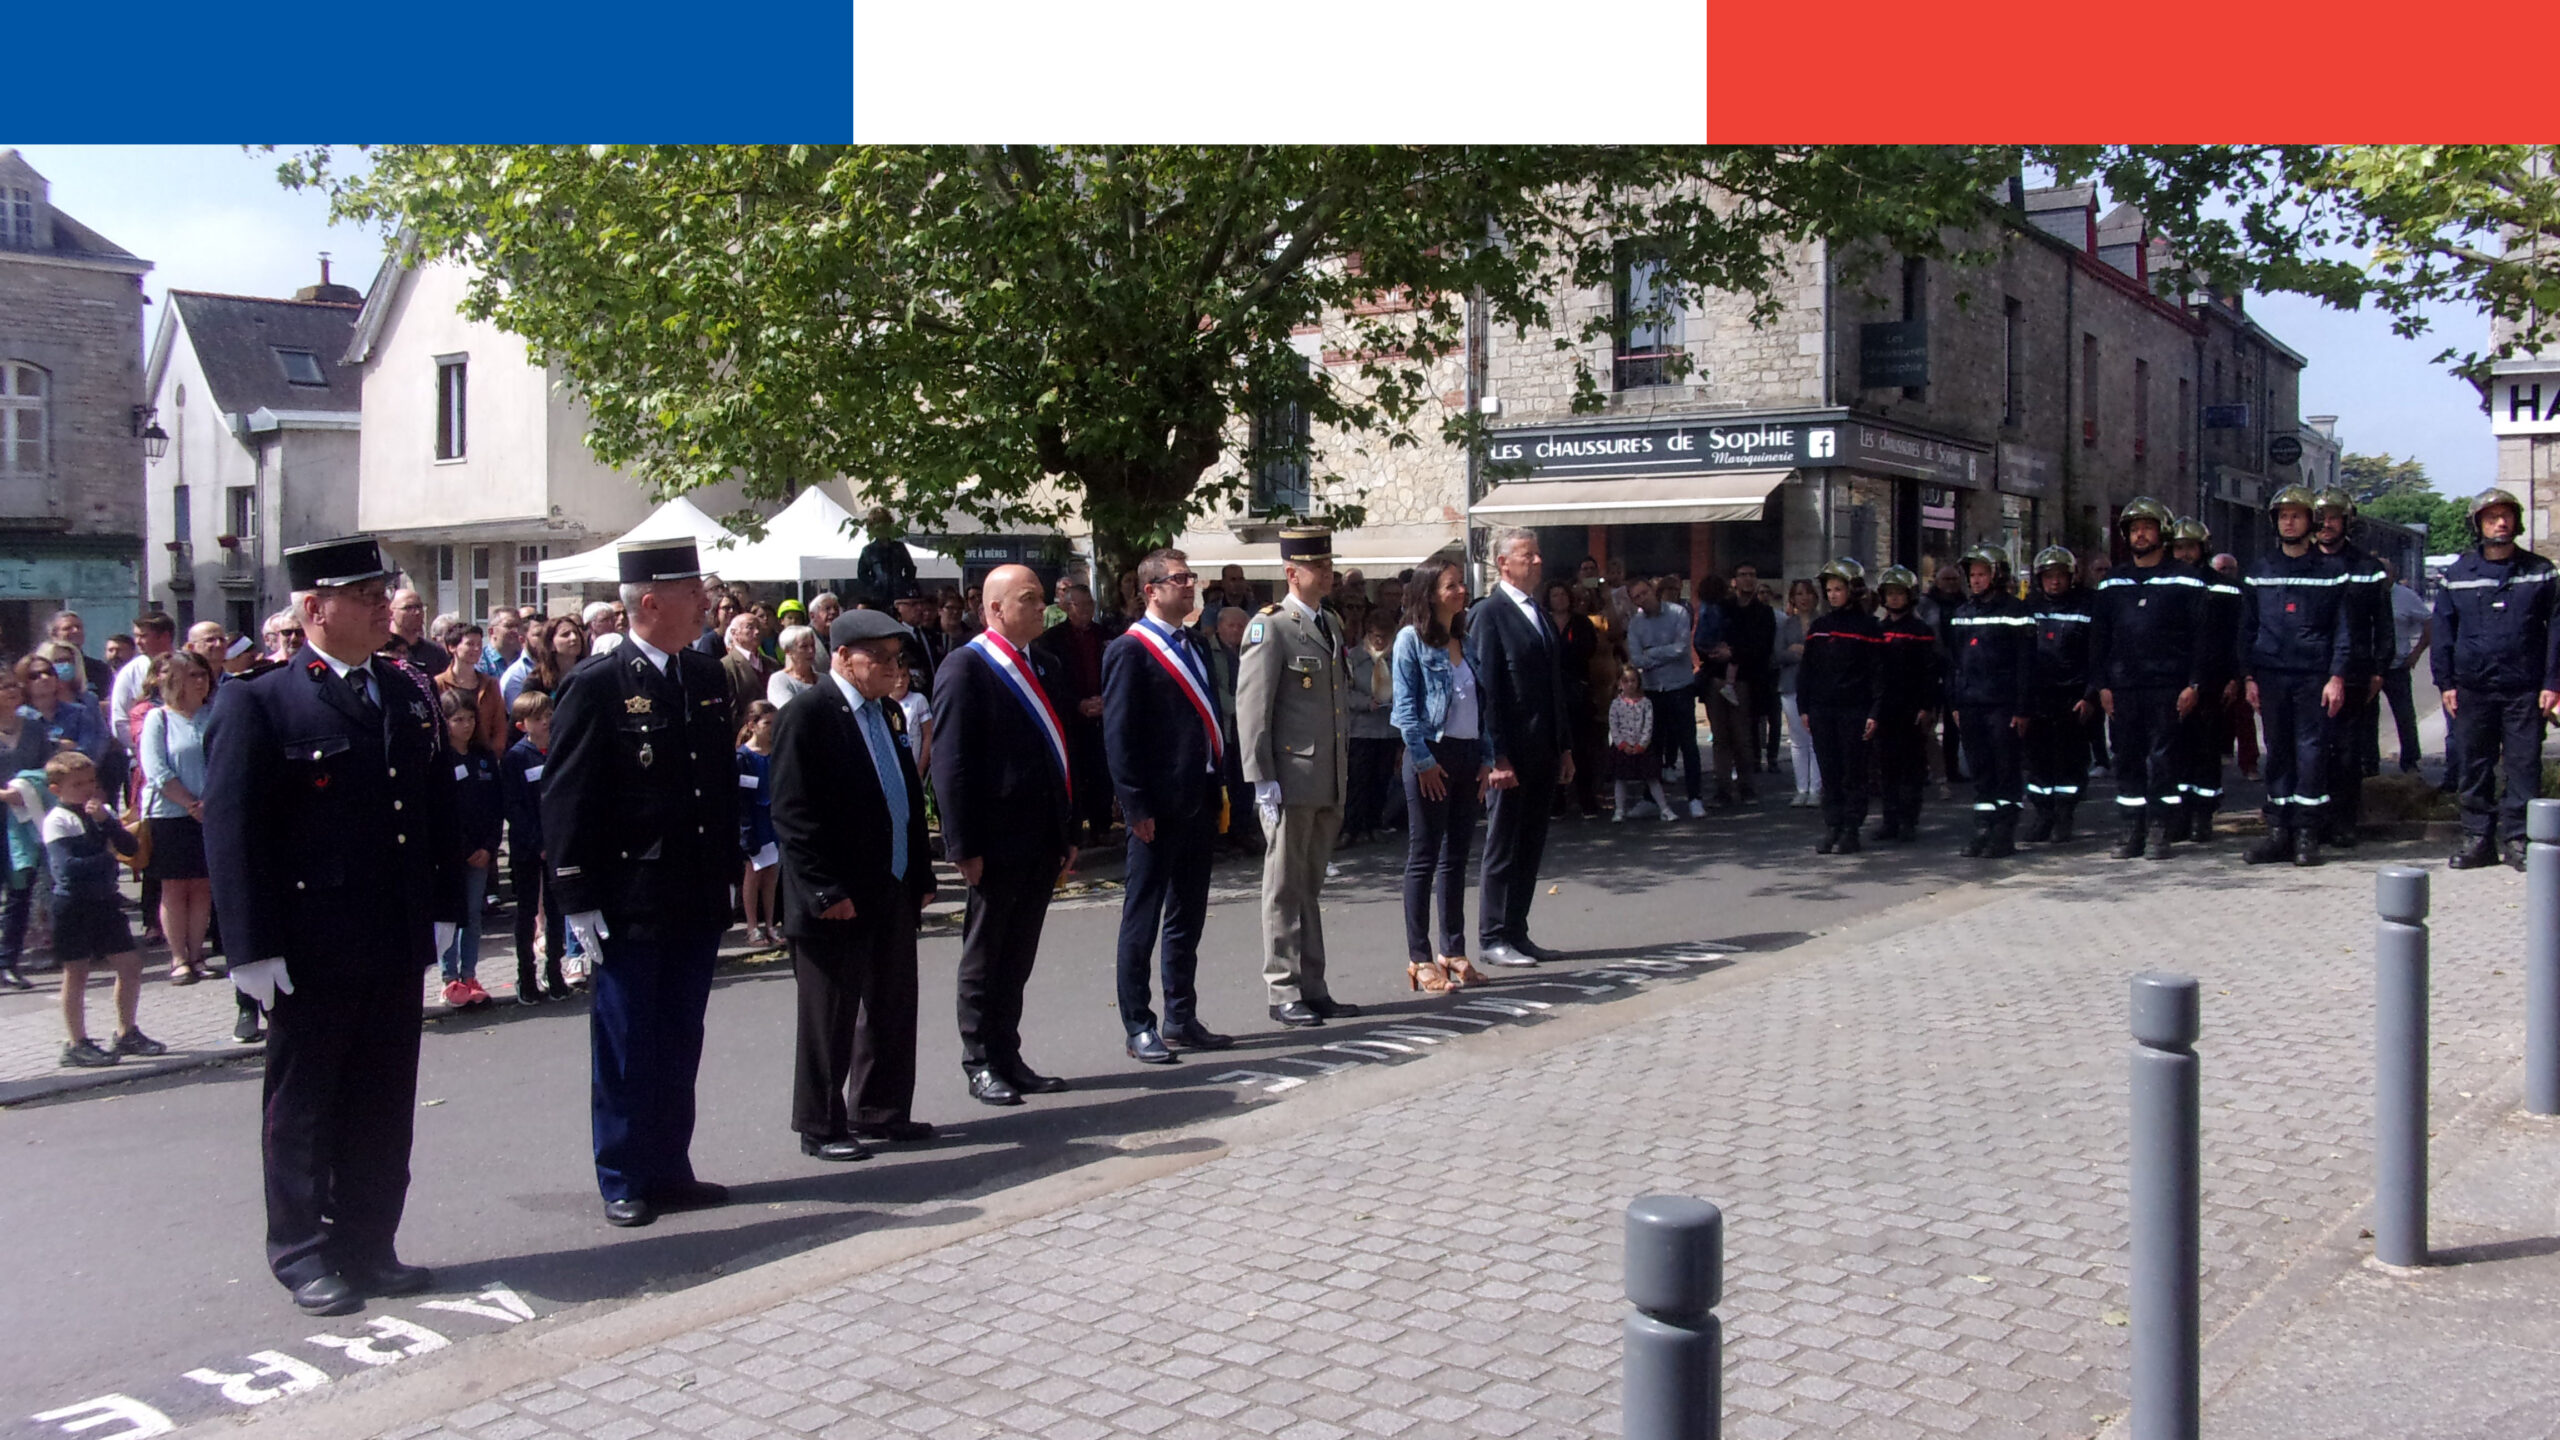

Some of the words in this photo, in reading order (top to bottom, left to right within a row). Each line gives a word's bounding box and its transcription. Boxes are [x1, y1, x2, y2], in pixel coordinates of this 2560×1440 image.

[1490, 443, 1523, 460] LES
[1711, 451, 1795, 466] Maroquinerie
[1207, 996, 1553, 1093] MINUTE
